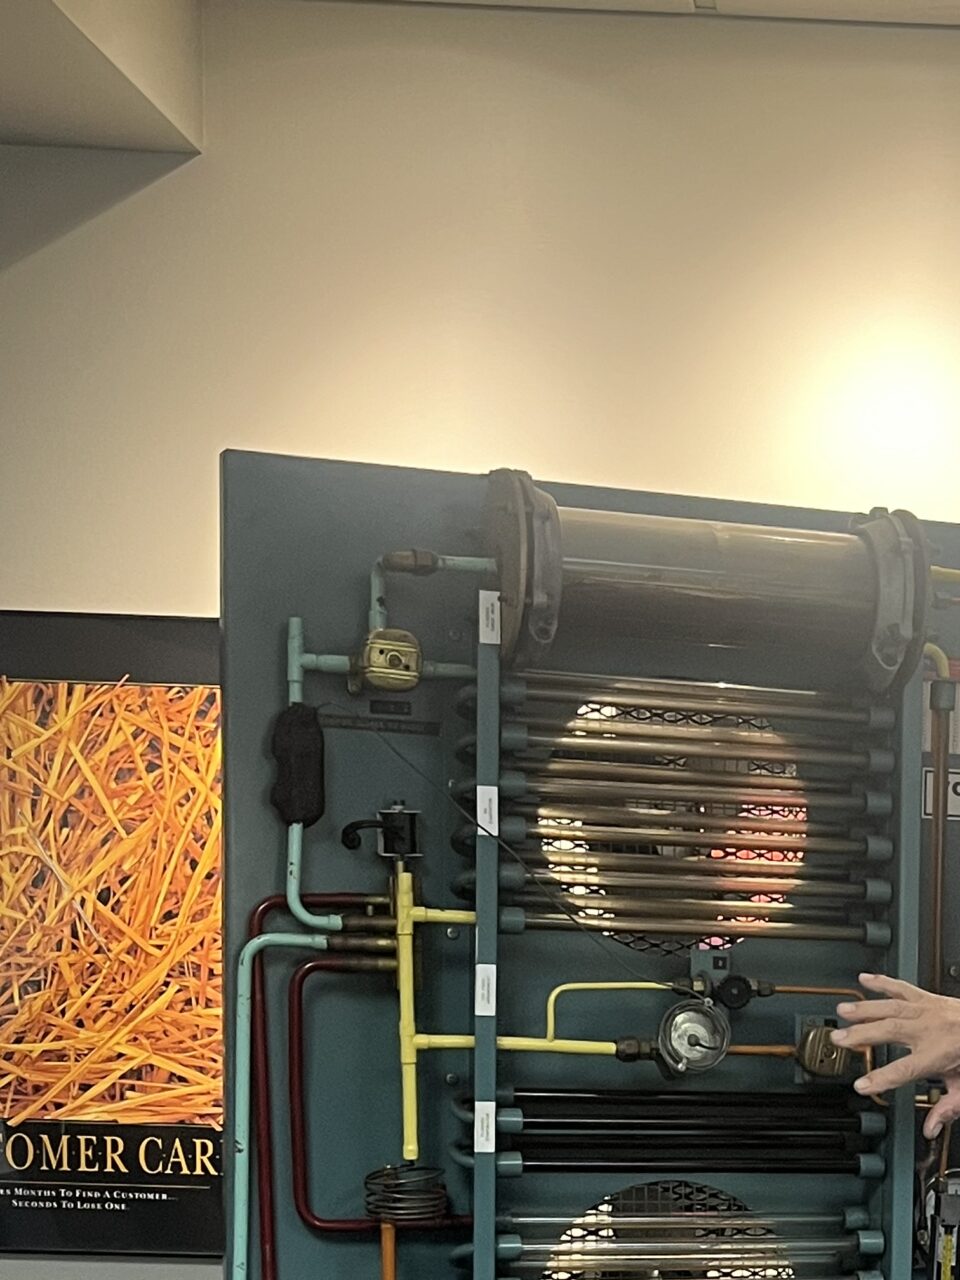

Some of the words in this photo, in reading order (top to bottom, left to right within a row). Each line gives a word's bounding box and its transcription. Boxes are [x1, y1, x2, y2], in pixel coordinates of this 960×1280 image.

[0, 1132, 129, 1173] OMER
[139, 1136, 223, 1176] CAR
[103, 1190, 110, 1199] A
